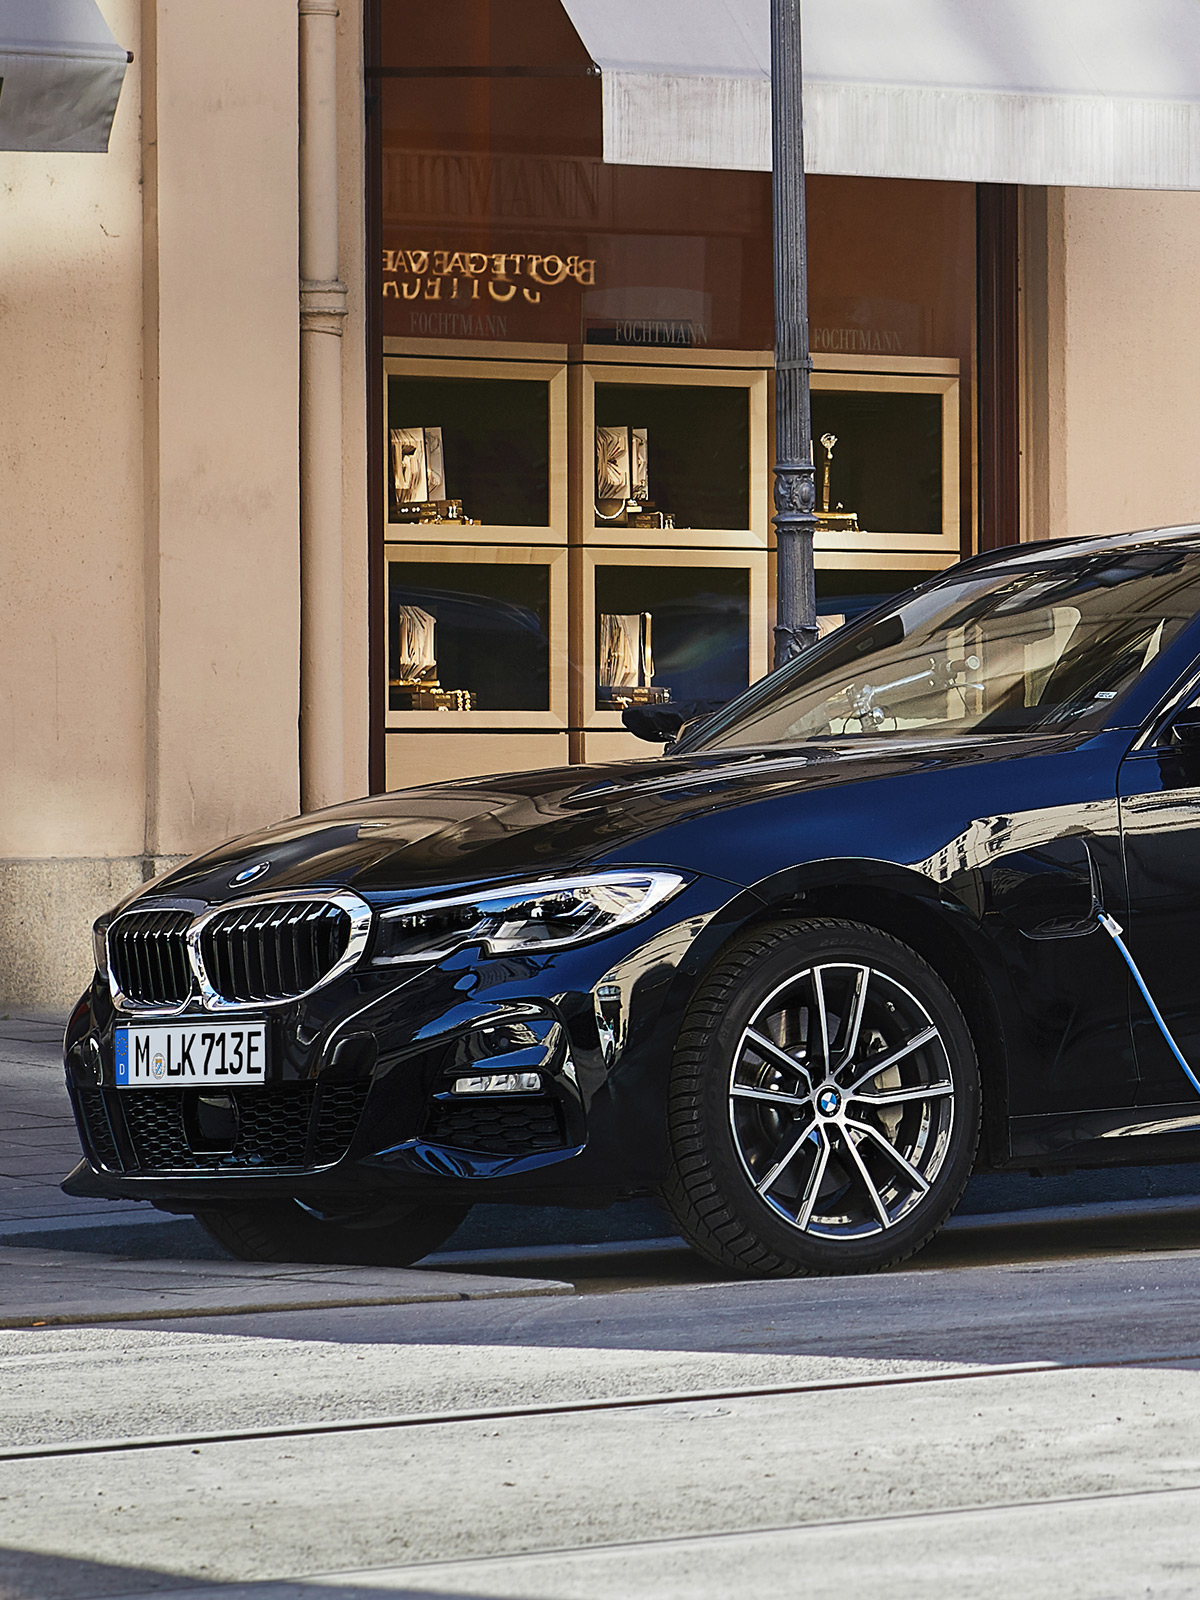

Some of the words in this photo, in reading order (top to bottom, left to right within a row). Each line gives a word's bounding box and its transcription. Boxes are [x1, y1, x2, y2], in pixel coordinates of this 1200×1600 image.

[409, 312, 508, 337] FOCHTMANN
[615, 320, 708, 344] FOCHTMANN
[813, 328, 904, 352] FOCHTMANN
[135, 1035, 150, 1077] M
[167, 1033, 197, 1076] LK
[201, 1031, 262, 1075] 713E
[119, 1063, 125, 1075] D
